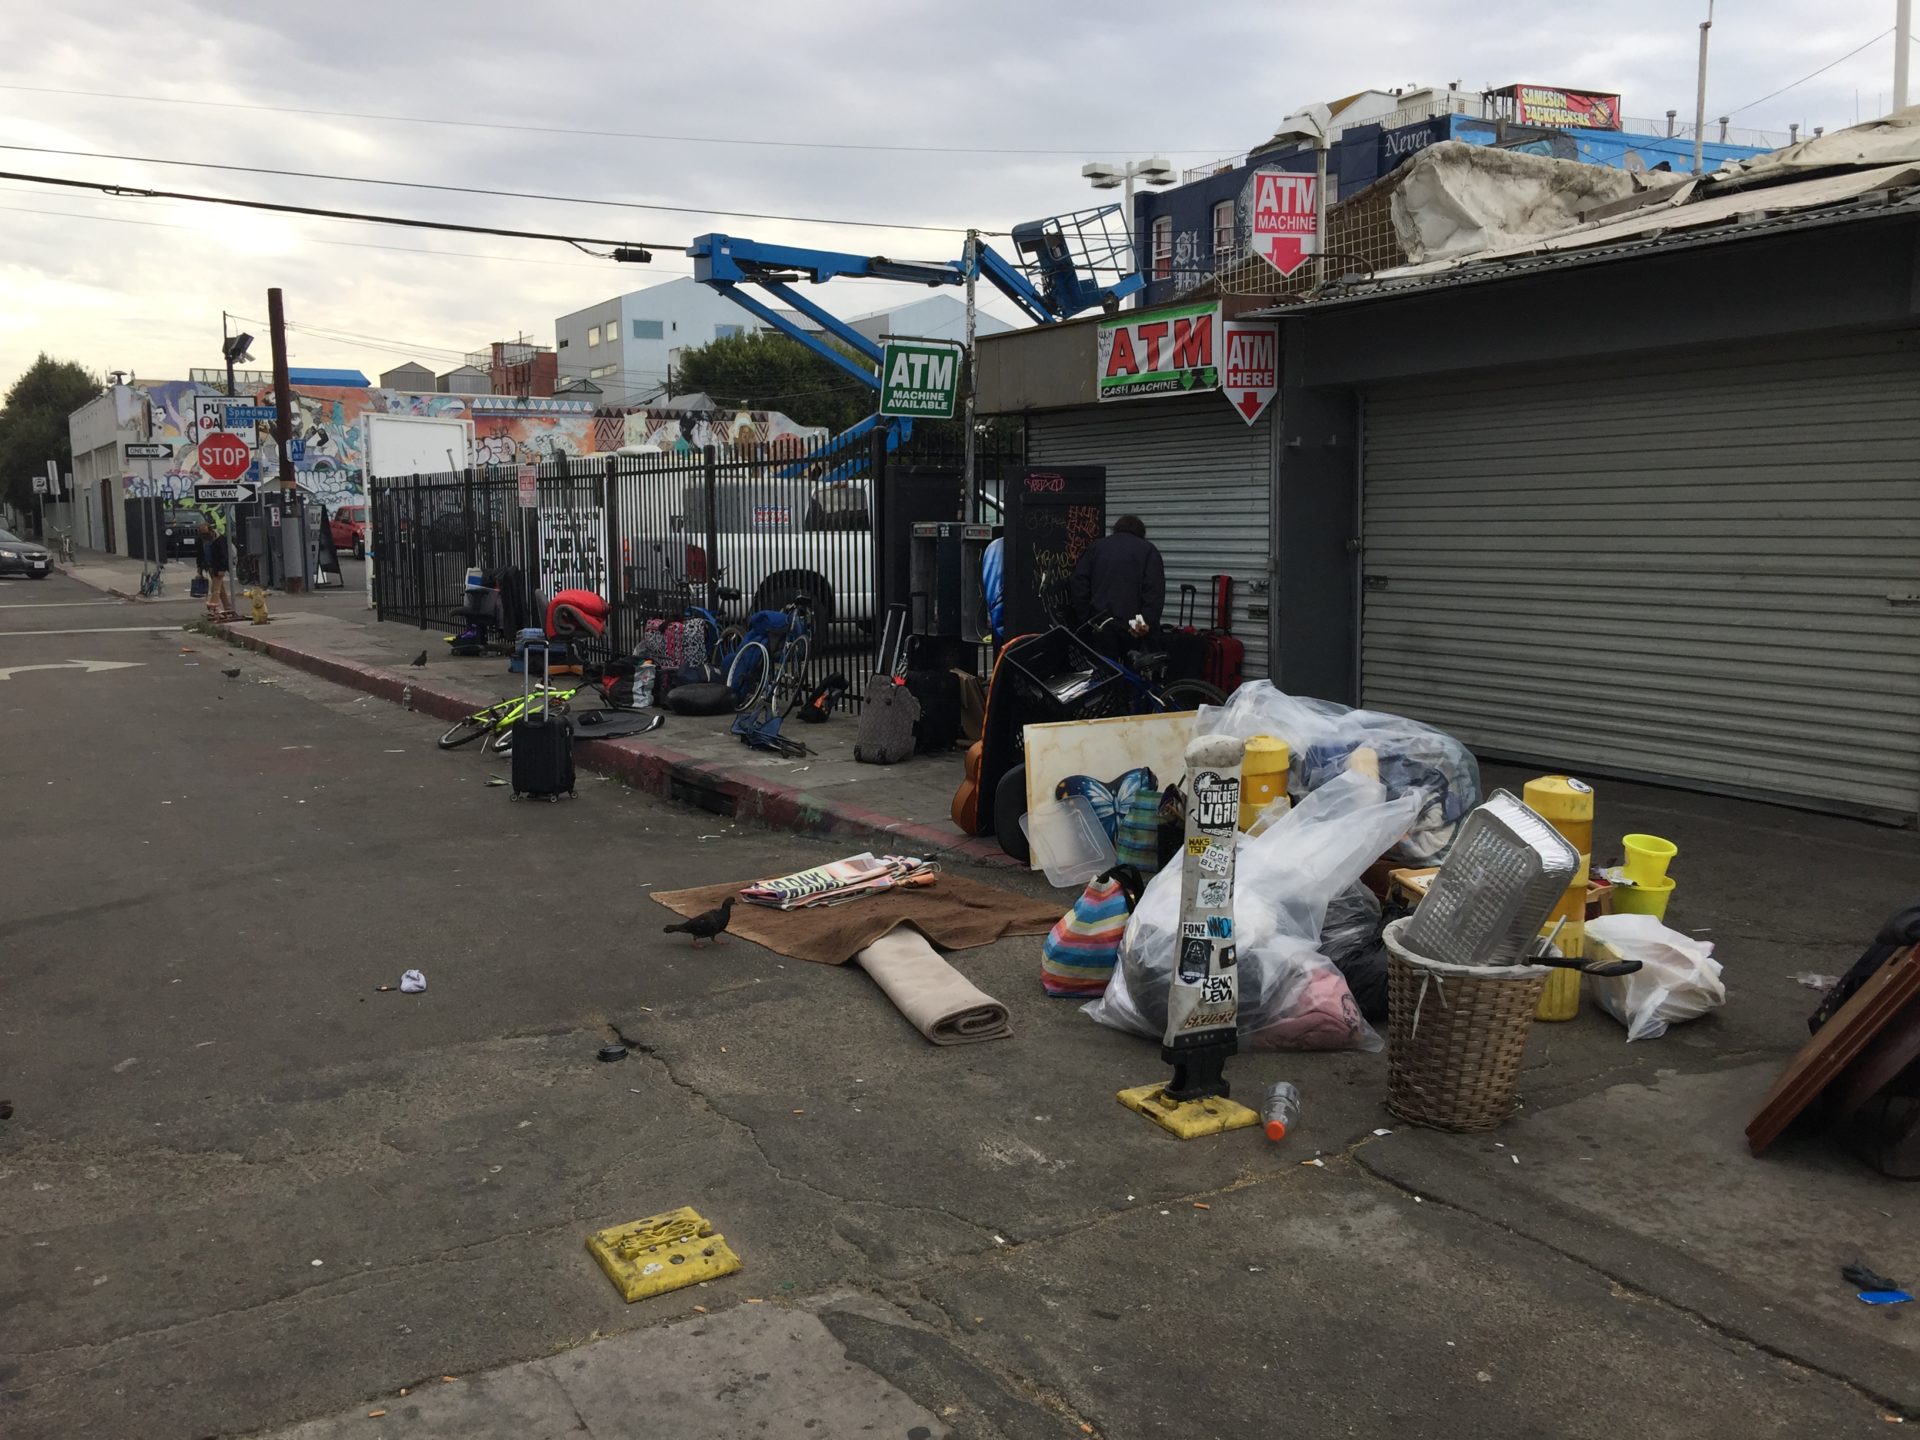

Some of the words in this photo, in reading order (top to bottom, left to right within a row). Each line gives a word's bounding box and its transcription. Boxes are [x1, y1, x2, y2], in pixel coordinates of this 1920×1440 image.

[1384, 128, 1432, 157] Never
[1257, 177, 1317, 215] ATM
[1257, 214, 1317, 231] MACHINE
[1106, 314, 1212, 377] ATM
[1228, 335, 1274, 371] ATM
[888, 352, 954, 391] ATM
[1228, 372, 1273, 387] HERE
[892, 390, 945, 401] MACHINE
[1102, 384, 1129, 396] CASH
[1130, 380, 1178, 394] MACHINE
[887, 398, 949, 410] AVAILABLE
[229, 407, 274, 419] Speedway
[202, 447, 246, 466] STOP
[200, 490, 218, 498] ONE
[1200, 790, 1238, 804] CONCRETE
[1183, 923, 1206, 934] FONZ
